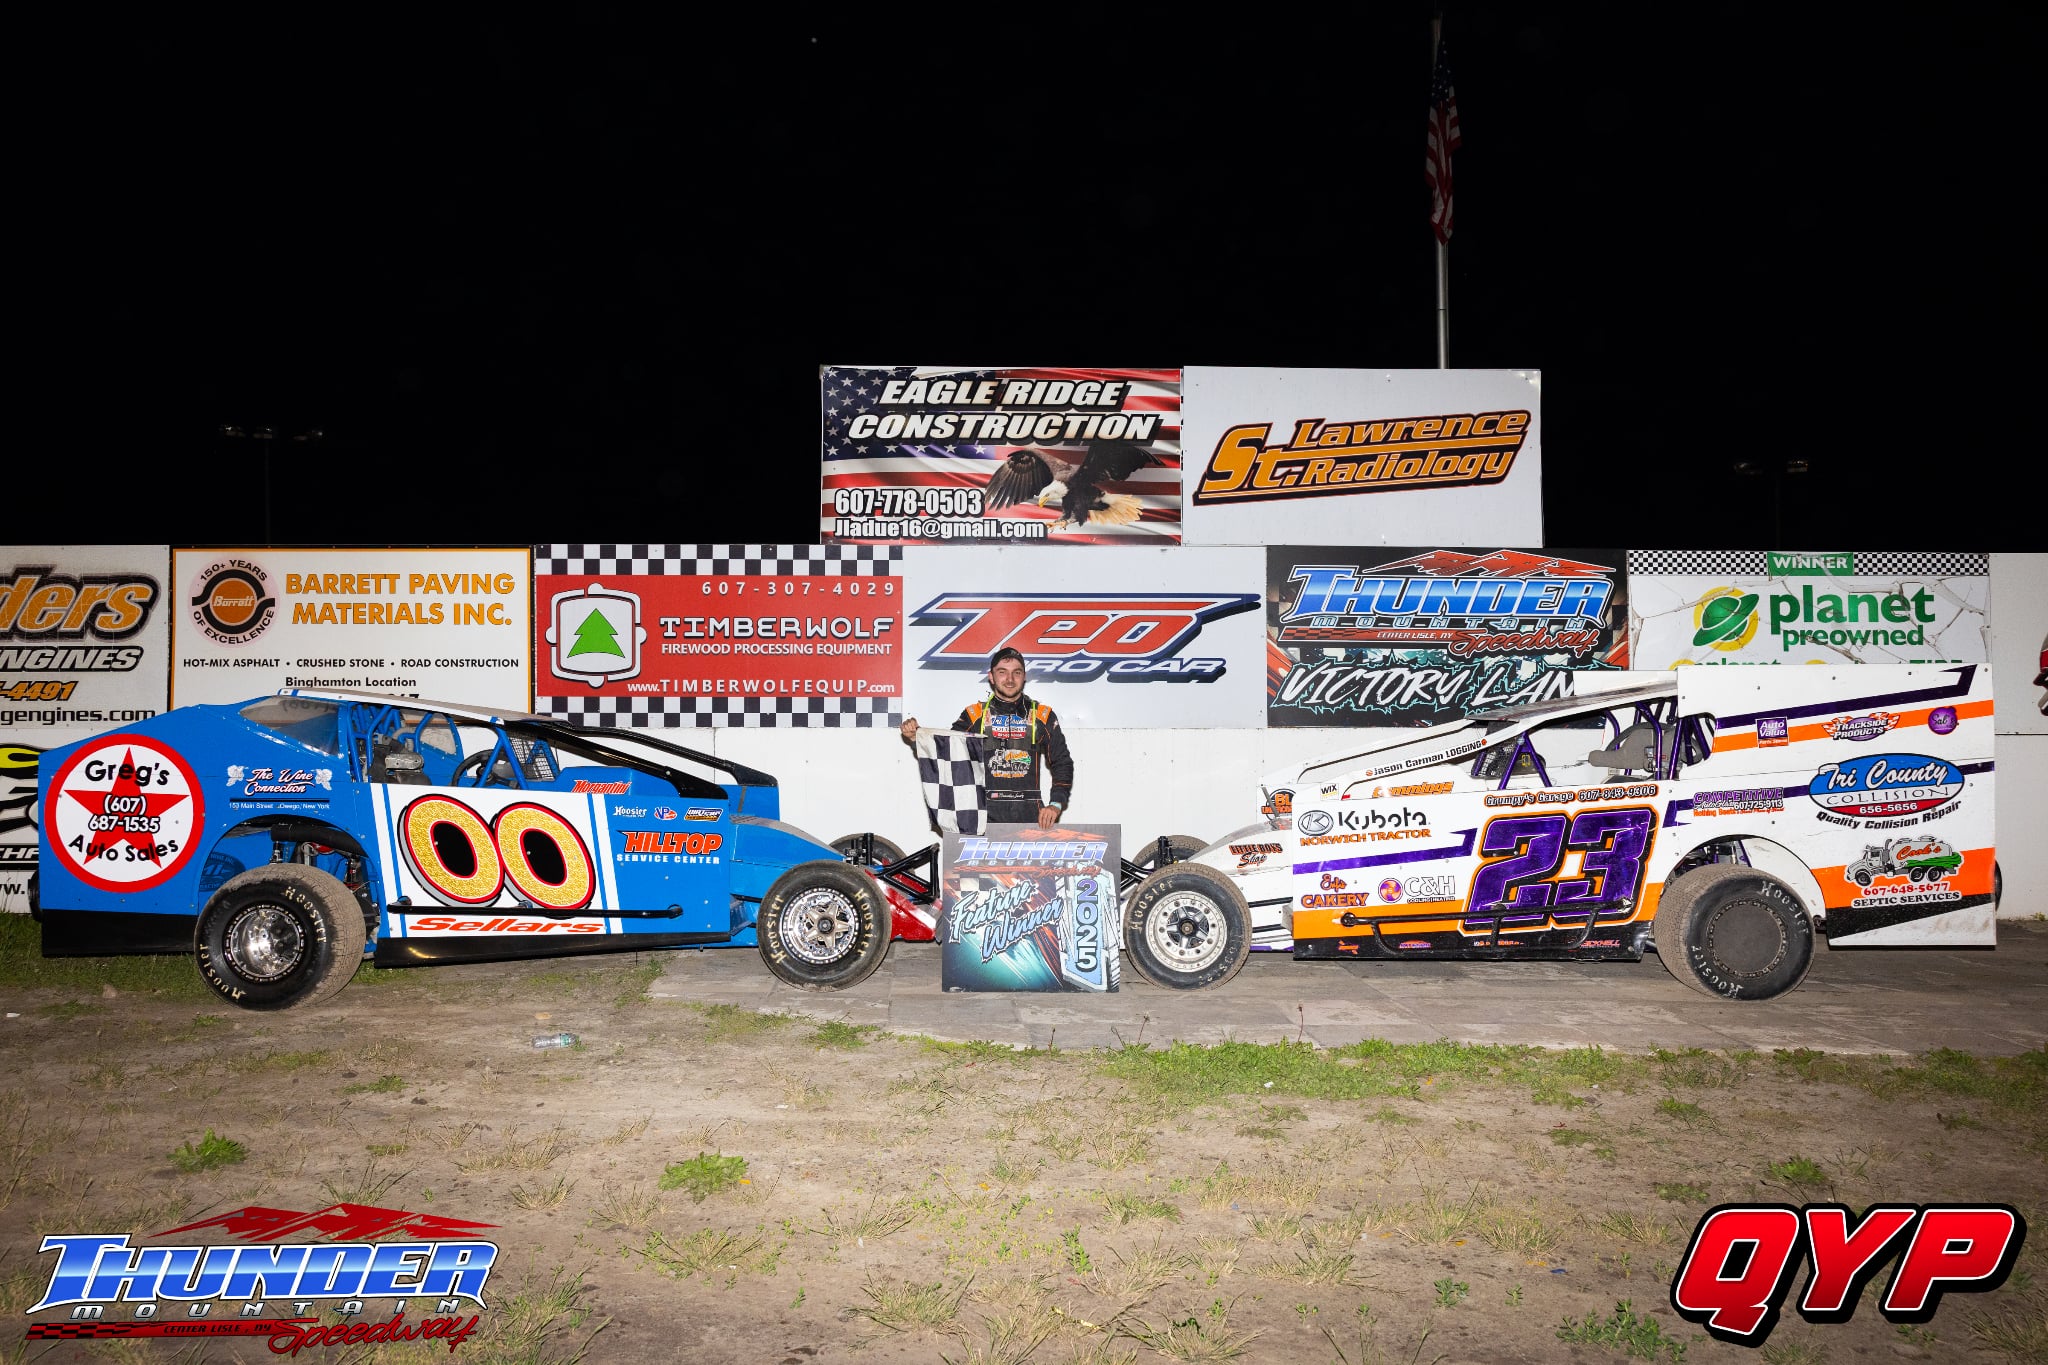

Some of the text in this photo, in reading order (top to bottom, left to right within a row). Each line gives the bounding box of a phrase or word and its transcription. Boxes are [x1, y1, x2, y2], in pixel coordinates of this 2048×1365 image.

[879, 379, 1126, 408] EAGLE RIDGE
[848, 413, 1158, 441] CONSTRUCTION
[1294, 411, 1528, 448] Lawrence
[1201, 426, 1298, 492] St.
[1302, 451, 1516, 484] Radiology
[833, 489, 984, 516] 607-778-0503
[200, 559, 268, 582] 150+ YEARS
[1773, 555, 1848, 570] WINNER
[285, 573, 516, 595] BARRETT PAVING
[702, 581, 895, 597] 607-307-4029
[213, 595, 256, 607] Barrett
[1282, 566, 1613, 627] THUNDER
[292, 603, 513, 626] MATERIALS INC.
[1769, 585, 1936, 635] planet
[193, 608, 275, 645] OF EXCELLENCE
[659, 617, 895, 639] TIMBERWOLF
[1309, 616, 1587, 629] MOUNTAIN
[1376, 631, 1454, 641] CENTER LISLE, NY
[1450, 628, 1599, 658] Speedway
[1783, 624, 1925, 651] preowned
[661, 643, 893, 657] FIREWOOD PROCESSING EQUIPMENT
[183, 658, 519, 668] HOT-MIX ASPHALT CRUSHED STONE ROAD CONSTRUCTION
[1024, 658, 1224, 673] RO CAR
[0, 681, 78, 702] -4491
[285, 676, 417, 688] Binghamton Location
[627, 679, 895, 694] www.TIMBERWOLFEQUIP.com
[1281, 664, 1575, 706] VICTORY LAN
[0, 706, 156, 726] gengines.com
[1760, 721, 1785, 730] Auto
[1835, 717, 1887, 731] TRACKSIDE
[1759, 729, 1786, 737] Value
[1832, 726, 1884, 740] PRODUCTS
[1405, 753, 1444, 767] Carman
[1446, 740, 1482, 758] LOGGING
[85, 760, 170, 787] Greg's
[246, 768, 314, 783] The Wine
[1818, 758, 1949, 791] Tri County
[244, 781, 316, 797] Connection
[1321, 784, 1337, 795] WIX
[1486, 784, 1657, 807] Grumpy's Garage 607-843-9306
[1693, 787, 1783, 804] COMPETITIVE
[1826, 786, 1949, 806] COLLISION
[104, 793, 147, 816] (607)
[613, 805, 648, 816] Hoosier
[1815, 800, 1962, 830] Quality Collision Repair
[1859, 802, 1918, 814] 656-5656
[88, 814, 161, 834] 687-1535
[1338, 807, 1428, 831] Kubota
[68, 834, 119, 861] Auto
[125, 839, 179, 862] Sales
[621, 831, 723, 855] HILLTOP
[1299, 828, 1432, 847] NORWICH TRACTOR
[401, 794, 596, 909] 00
[616, 854, 720, 864] SERVICE CENTER
[954, 838, 1109, 864] THUNDER
[1896, 842, 1942, 861] Cook's
[1463, 806, 1656, 930] 23
[1404, 875, 1455, 897] C&H
[1863, 882, 1949, 896] 607-648-5677
[1301, 892, 1370, 909] CAKERY
[1853, 891, 1960, 907] SEPTIC SERVICES
[952, 880, 1032, 941] Feature
[408, 918, 605, 934] Sellars
[981, 898, 1064, 960] Winner
[1075, 878, 1099, 972] 2025
